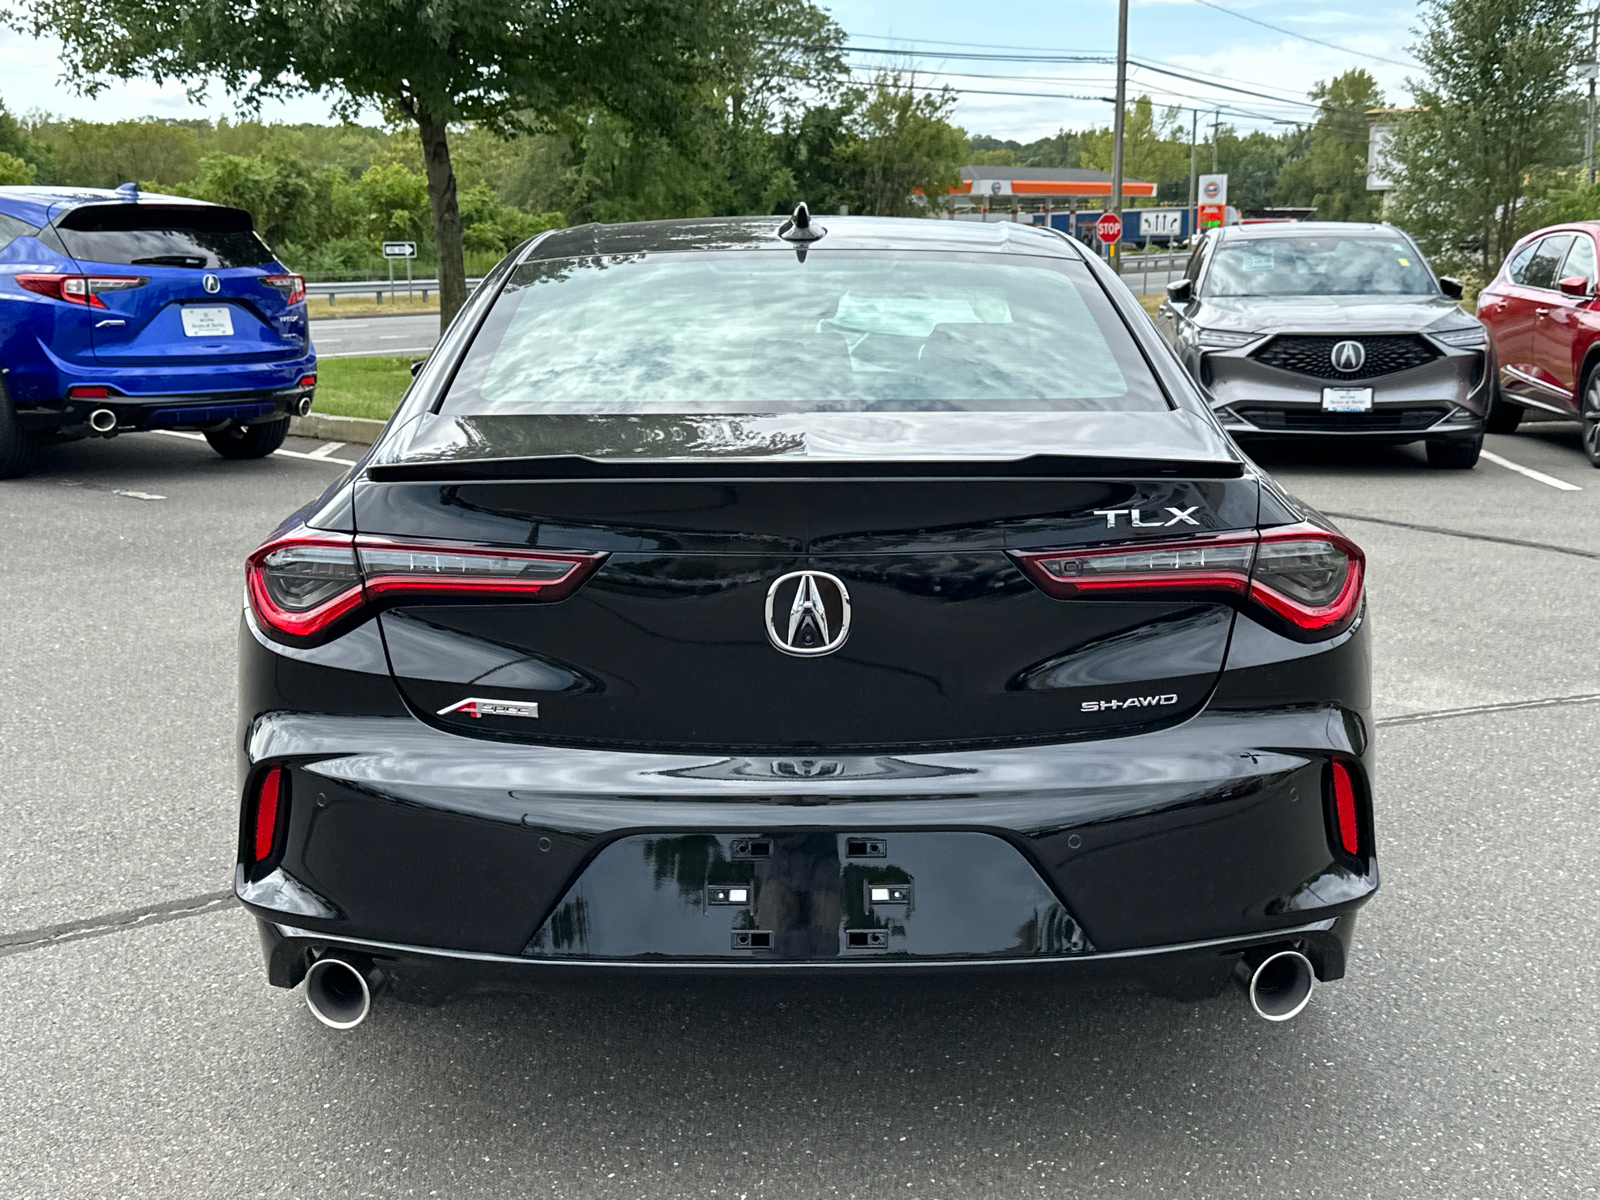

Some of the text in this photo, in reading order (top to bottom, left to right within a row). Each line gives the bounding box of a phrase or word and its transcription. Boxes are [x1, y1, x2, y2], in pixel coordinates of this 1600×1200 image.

[1098, 222, 1121, 235] STOP
[1093, 506, 1200, 529] TLX
[1080, 693, 1178, 712] SH-AWD
